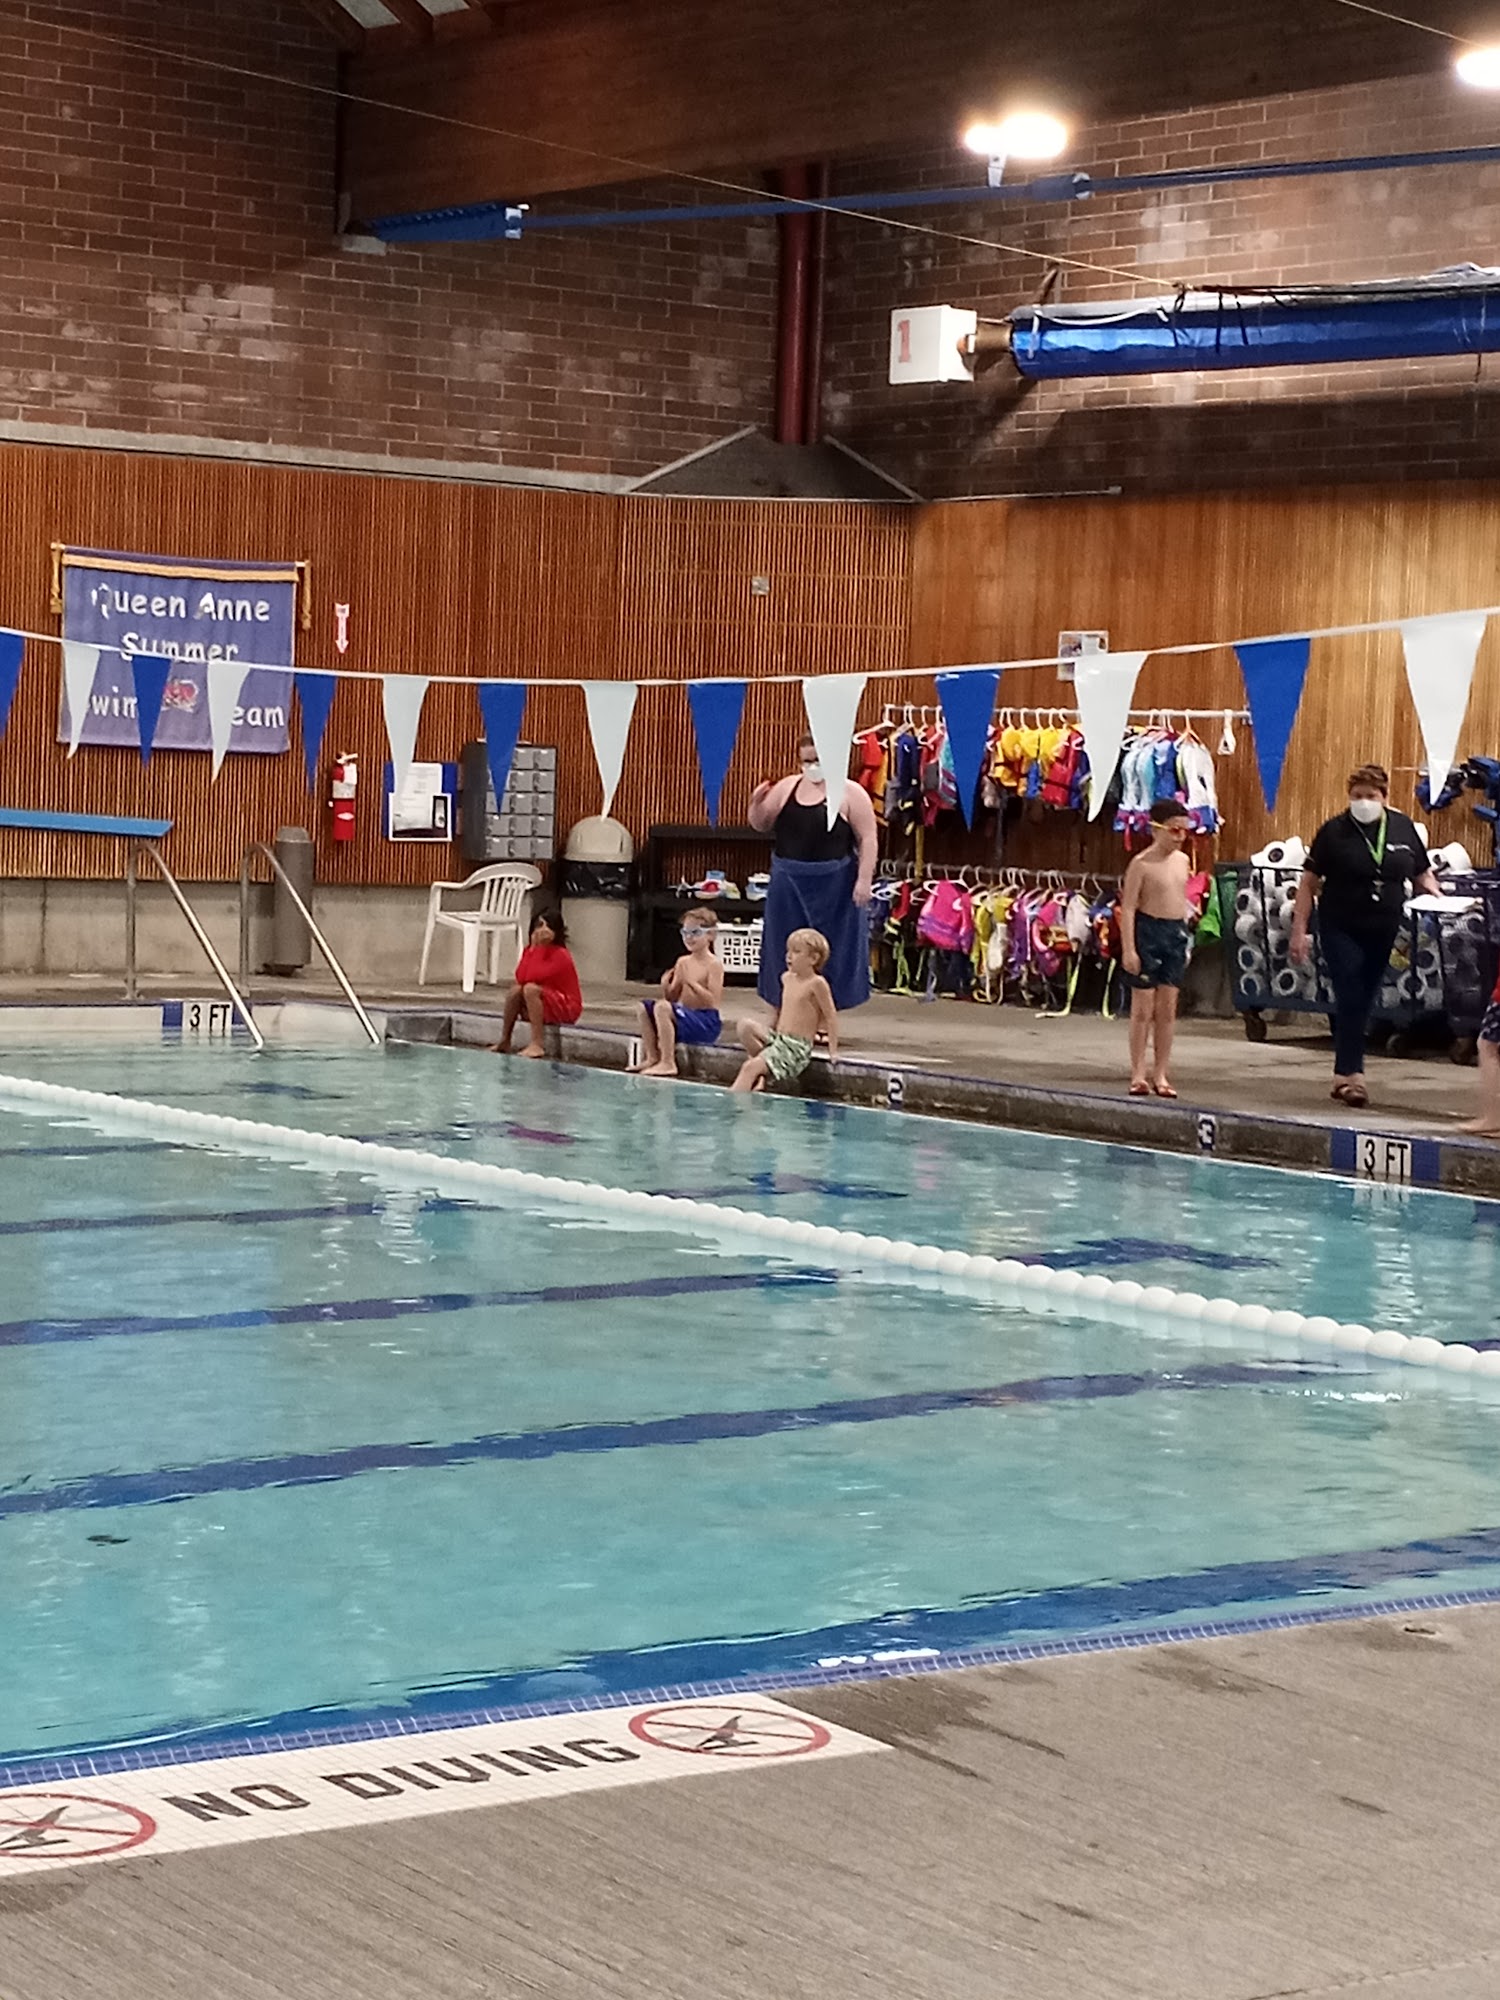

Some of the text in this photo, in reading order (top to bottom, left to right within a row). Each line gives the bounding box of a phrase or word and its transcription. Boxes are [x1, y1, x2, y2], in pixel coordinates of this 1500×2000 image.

[897, 319, 911, 363] 1
[192, 592, 271, 622] Anne
[120, 631, 239, 662] Summer
[231, 704, 285, 729] eam
[189, 1004, 230, 1031] 3 FT
[888, 1078, 903, 1104] 2
[1199, 1119, 1215, 1150] 3
[1364, 1139, 1409, 1177] 3 FT
[162, 1739, 641, 1822] NO DIVING
